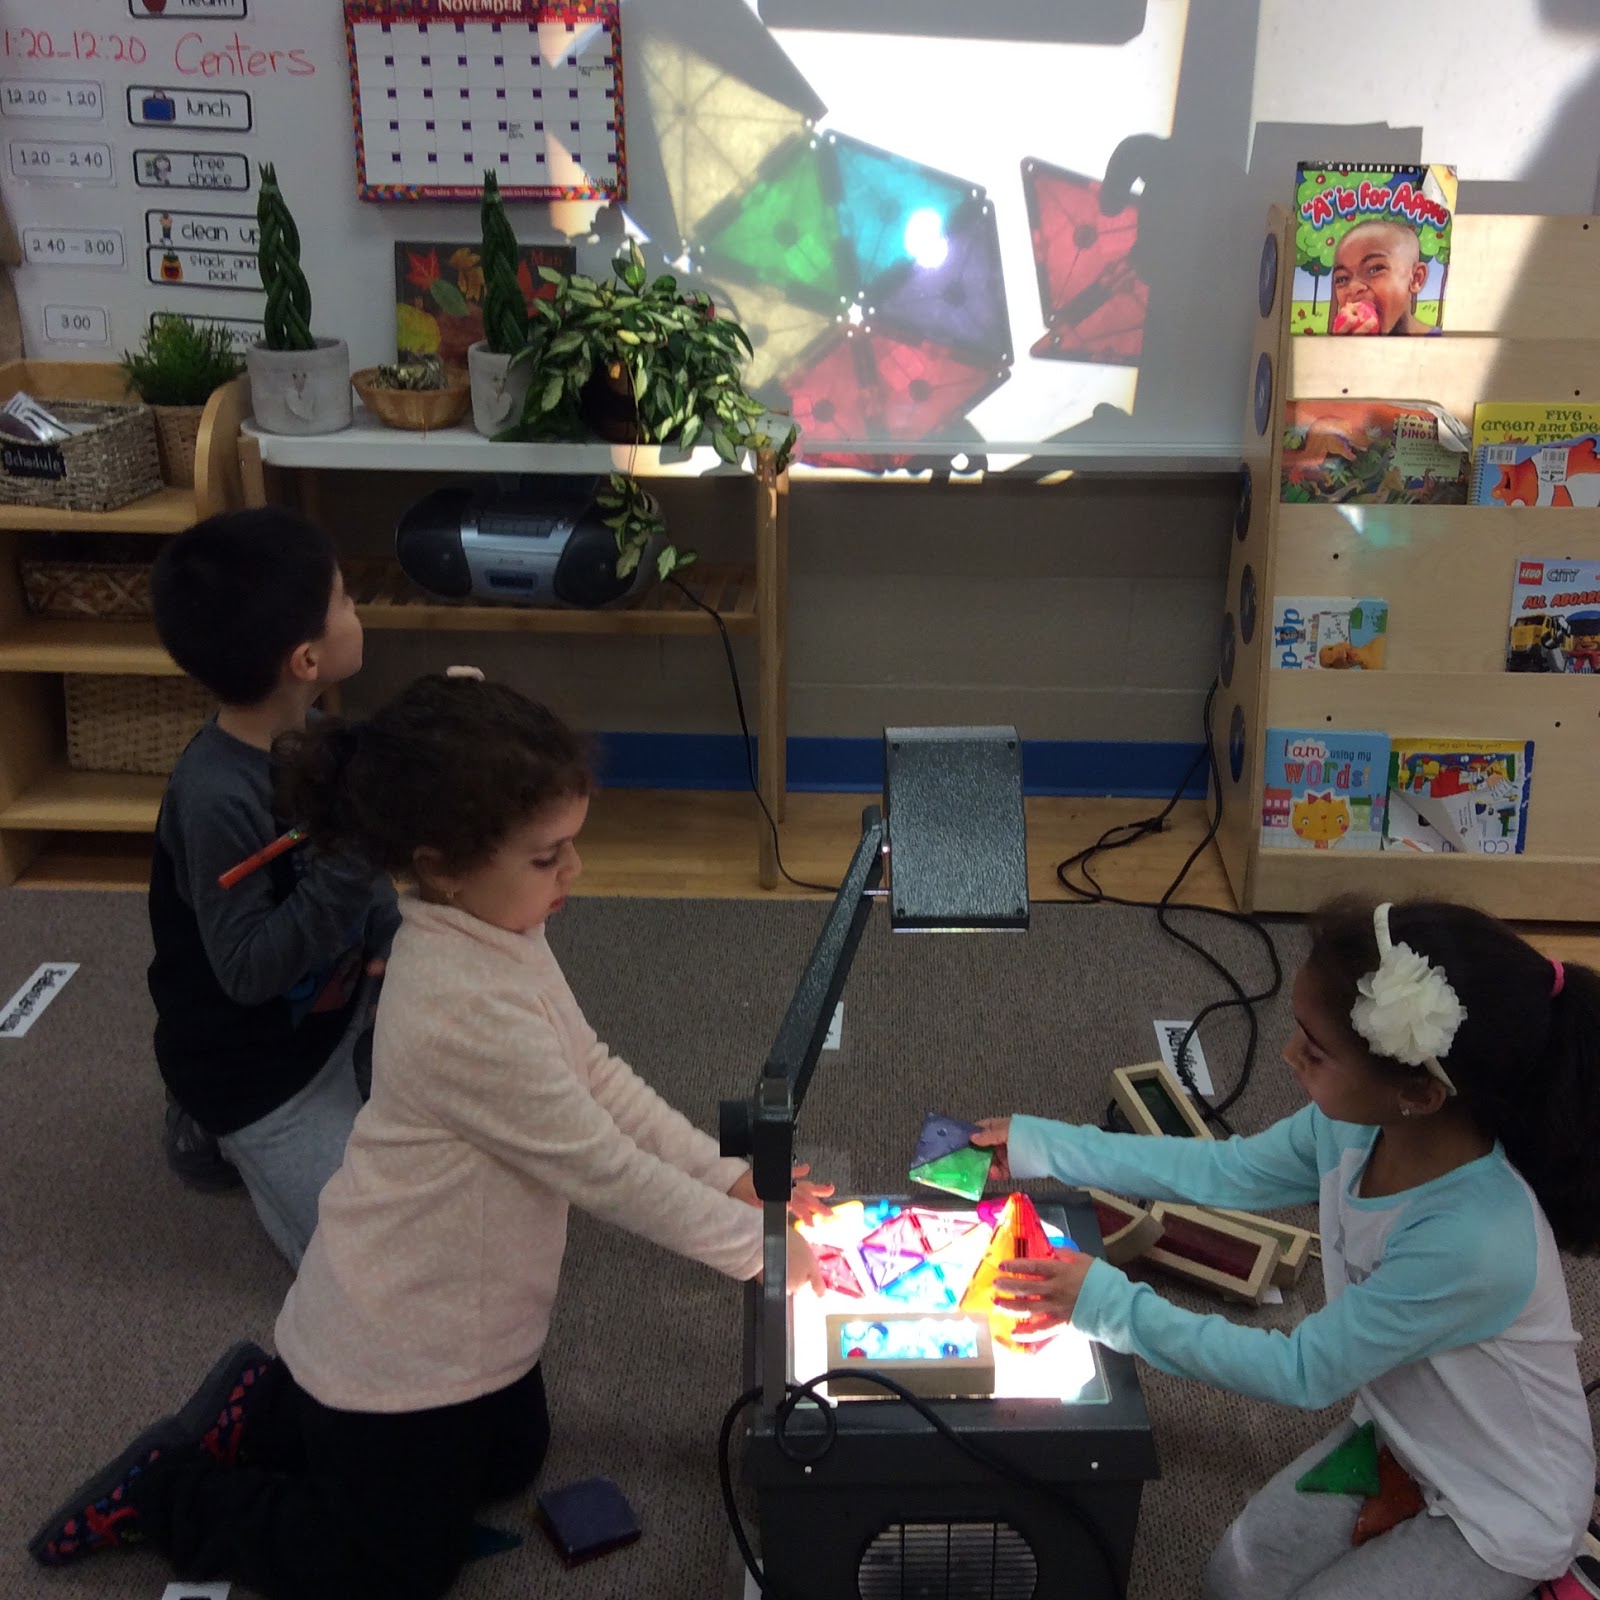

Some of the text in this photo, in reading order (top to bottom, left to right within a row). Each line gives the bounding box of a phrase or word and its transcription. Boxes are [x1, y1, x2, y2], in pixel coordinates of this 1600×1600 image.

[175, 31, 316, 77] Centers
[186, 97, 231, 117] lunch
[192, 154, 225, 170] free
[188, 172, 232, 187] choice
[181, 221, 260, 245] clean up
[233, 256, 257, 270] and
[208, 269, 238, 281] pack
[1401, 429, 1439, 440] DINOSA
[5, 450, 61, 472] Schedule
[1547, 568, 1580, 582] CITY
[1522, 595, 1547, 610] ALL
[1283, 739, 1372, 762] I am using my
